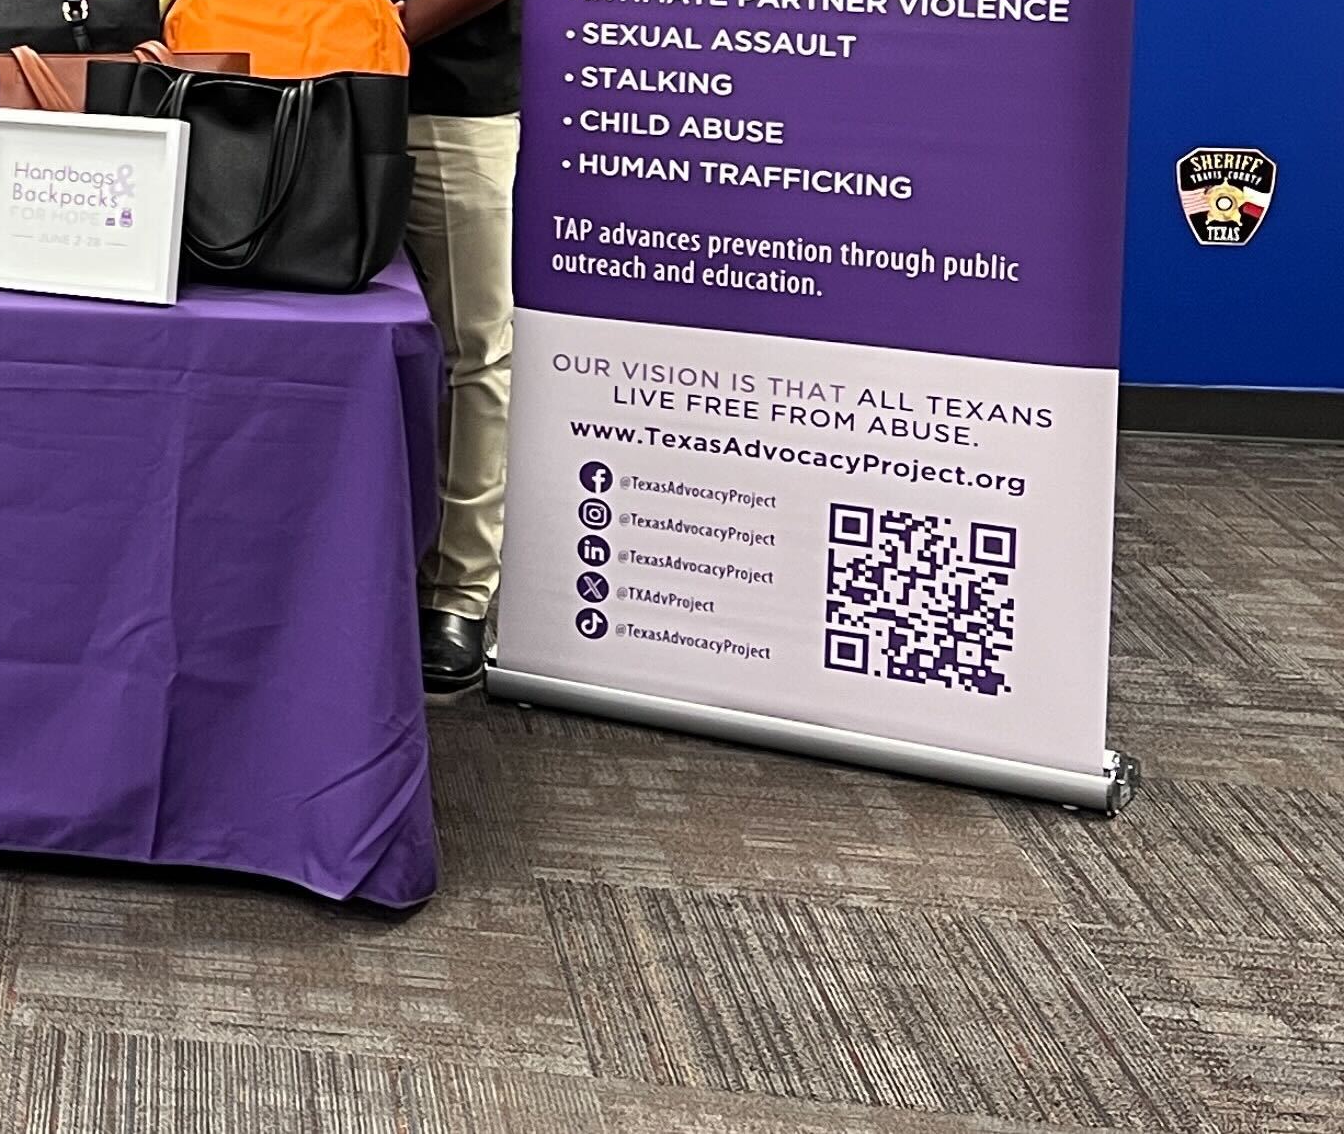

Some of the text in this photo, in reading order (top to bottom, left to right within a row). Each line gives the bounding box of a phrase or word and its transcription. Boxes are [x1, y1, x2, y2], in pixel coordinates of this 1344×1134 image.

[583, 23, 856, 57] SEXUAL ASSAULT
[582, 67, 732, 95] STALKING
[580, 110, 783, 143] CHILD ABUSE
[580, 154, 911, 198] HUMAN TRAFFICKING
[1190, 153, 1263, 172] SHERIFF
[1190, 171, 1262, 185] TRAVIS COUNTY
[12, 183, 118, 208] Backpacks
[14, 162, 135, 197] Handbags &
[52, 211, 100, 226] HOPE
[1207, 226, 1240, 242] TEXAS
[554, 216, 1018, 281] TAP advances prevention through public
[553, 254, 822, 296] outreach and education.
[553, 354, 1052, 428] OUR VISION IS THAT ALL TEXANS
[615, 386, 979, 447] LIVE FREE FROM ABUSE.
[571, 421, 1025, 496] www.TexasAdvocacyProject.org
[620, 476, 776, 509] @TexasAdvocacyProject
[620, 513, 774, 546] @TexasAdvocacyProject
[619, 550, 772, 583] @TexasAdvocacyProject
[617, 587, 714, 613] @TXAdvProject
[616, 624, 770, 659] @TexasAdvocacyProject
